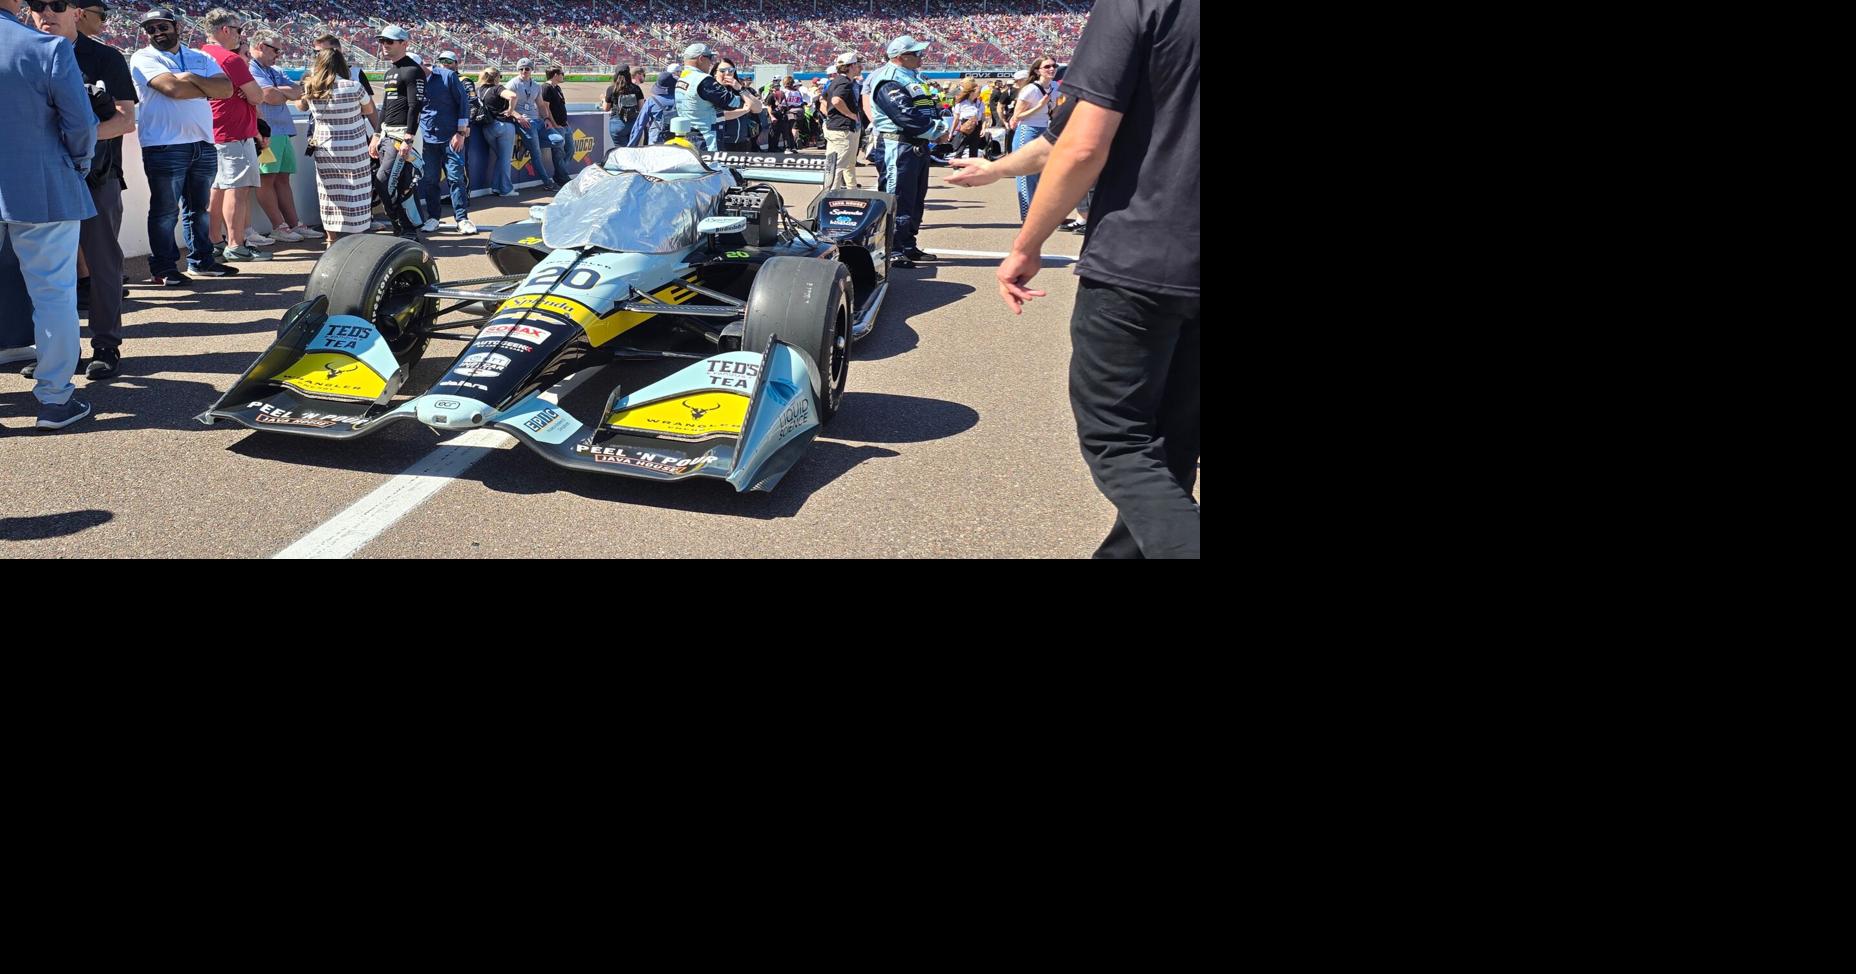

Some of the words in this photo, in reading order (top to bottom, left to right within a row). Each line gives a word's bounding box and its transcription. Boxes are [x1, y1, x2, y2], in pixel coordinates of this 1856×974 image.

[524, 265, 601, 290] 20
[371, 267, 393, 323] irestone
[324, 339, 358, 350] TEA
[706, 359, 760, 377] TED'S
[709, 375, 748, 389] TEA
[247, 401, 293, 419] PEEL
[525, 408, 559, 432] EPIC
[779, 399, 809, 428] LIQUID
[778, 412, 809, 440] SCIENCE
[576, 444, 627, 457] PEEL
[662, 455, 719, 468] POUR
[601, 456, 631, 464] JAVA
[636, 460, 676, 473] HOUSE
